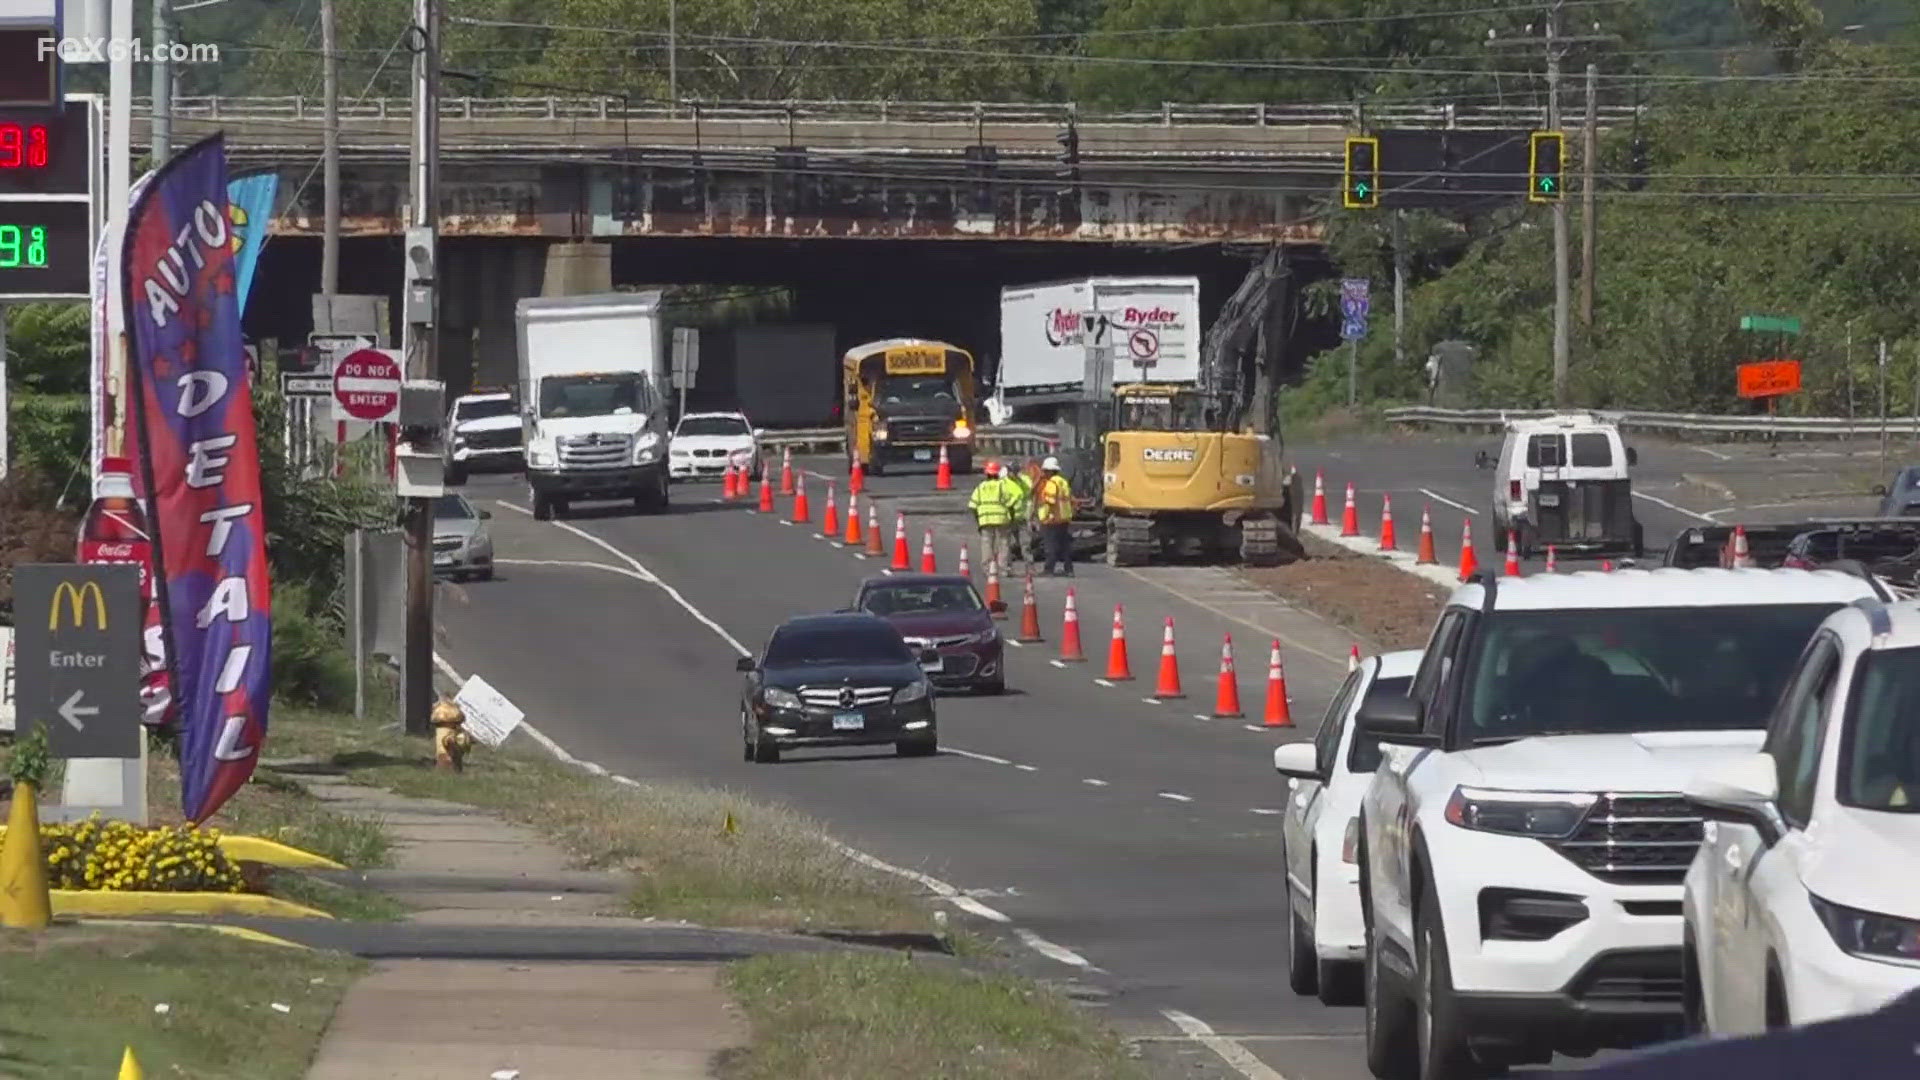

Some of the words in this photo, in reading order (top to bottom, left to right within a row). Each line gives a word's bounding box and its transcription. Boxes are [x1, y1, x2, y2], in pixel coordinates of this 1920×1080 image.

[144, 200, 227, 328] AUTO
[1124, 307, 1178, 324] Ryder
[345, 364, 361, 376] DO
[368, 365, 393, 376] NOT
[348, 394, 388, 406] ENTER
[1143, 448, 1194, 461] DEERE
[175, 369, 255, 762] DETAIL
[49, 650, 106, 667] Enter
